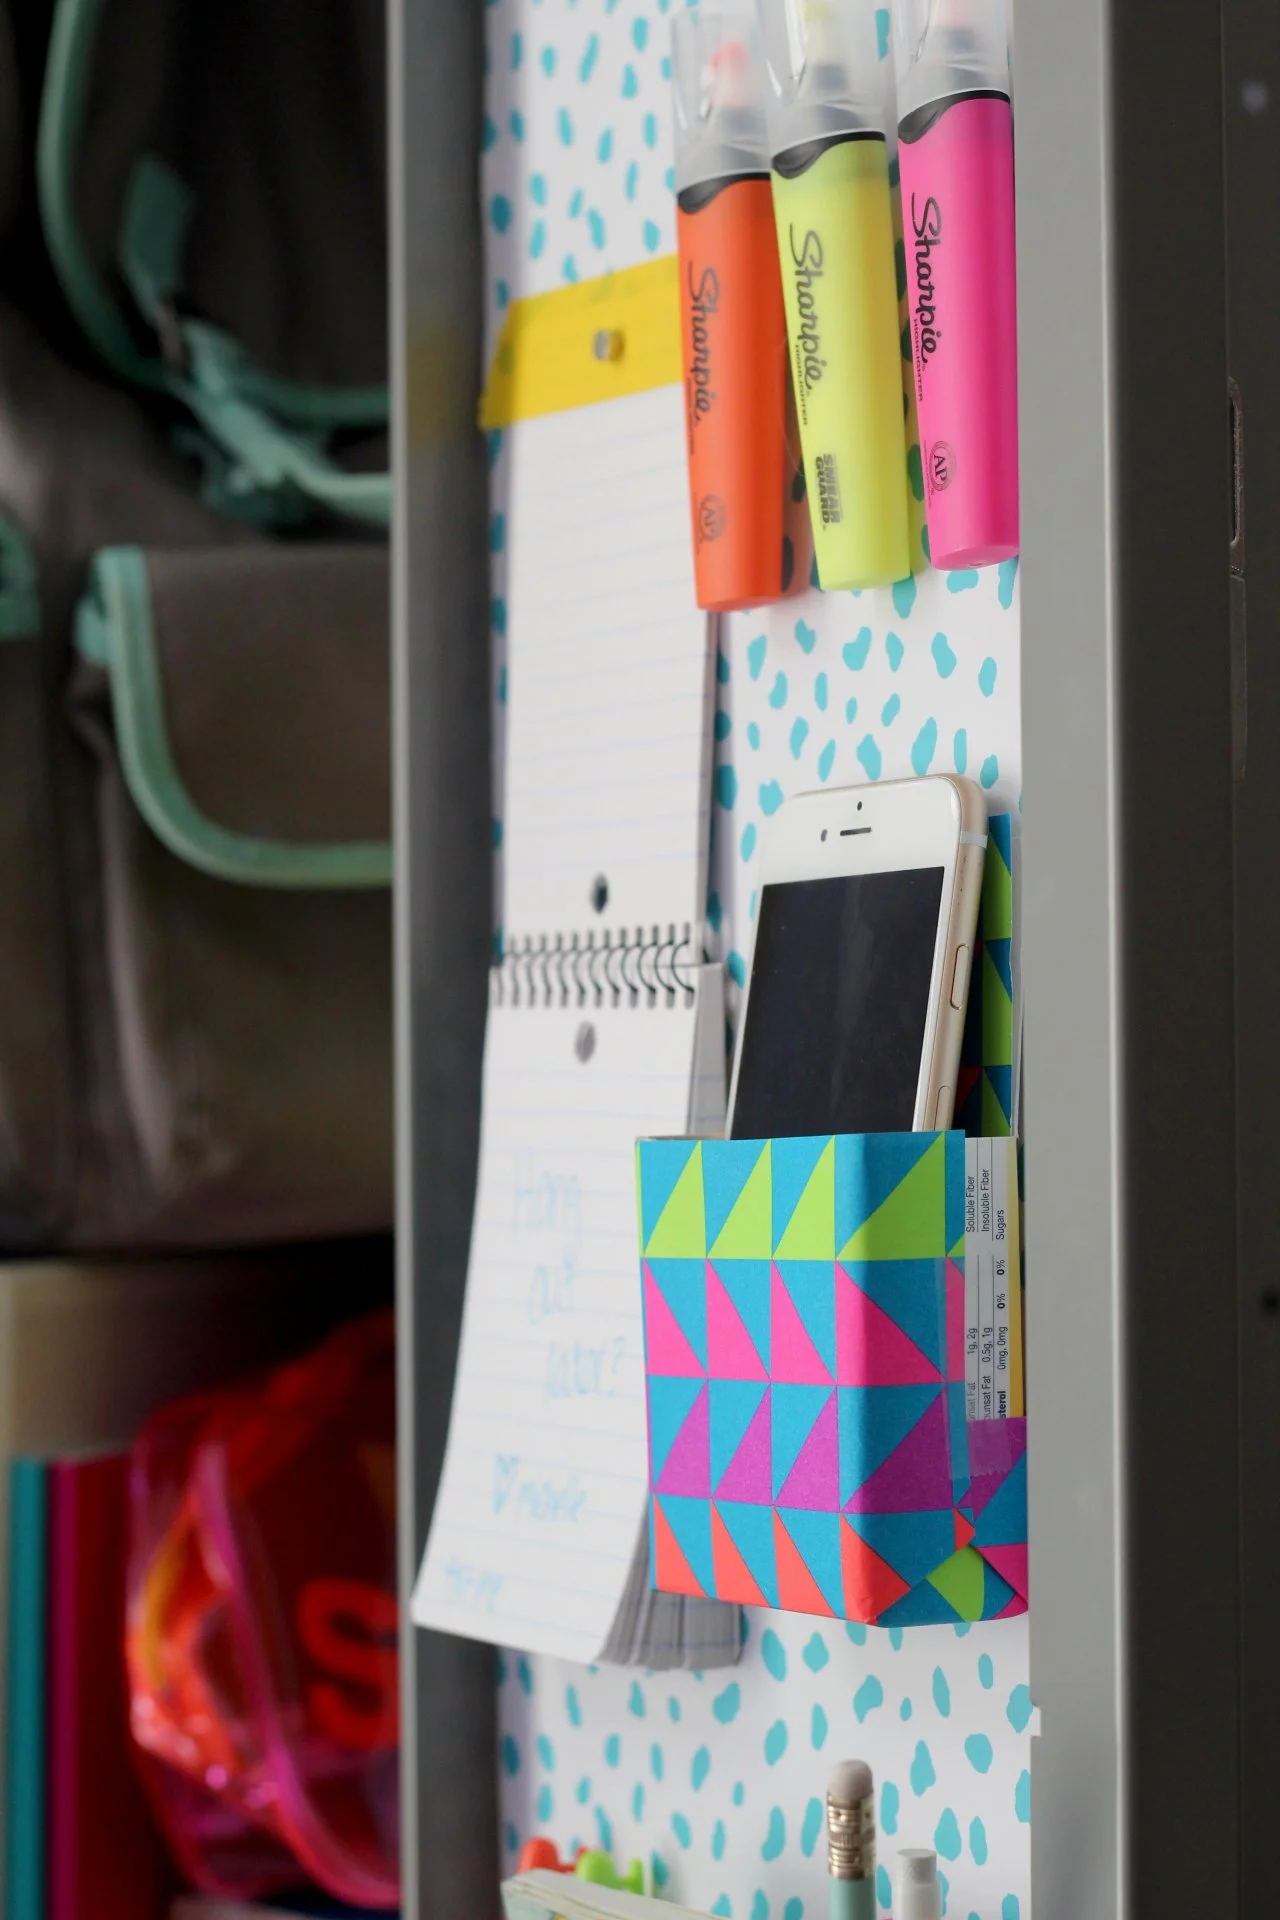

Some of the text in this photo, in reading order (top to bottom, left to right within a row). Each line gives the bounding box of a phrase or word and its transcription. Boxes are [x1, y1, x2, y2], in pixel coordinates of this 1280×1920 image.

[911, 192, 942, 364] Sharpie
[789, 223, 828, 392] Sharpie
[689, 259, 719, 422] Sharpie
[913, 318, 924, 403] HIGHLIGHTER
[795, 344, 808, 426] HIGHLIGHTER
[934, 455, 948, 481] AP
[816, 456, 830, 524] GUARD
[824, 453, 841, 524] SMEAR
[966, 1176, 975, 1232] Soluble Fiber
[981, 1169, 989, 1232] Insoluble Fiber
[996, 1209, 1006, 1240] Sugars
[996, 1259, 1006, 1276] 0%
[997, 1293, 1006, 1310] 0%
[967, 1327, 978, 1339] 2g
[982, 1327, 993, 1338] 1g
[997, 1326, 1008, 1346] 0mg
[967, 1341, 978, 1354] 1g,
[982, 1341, 993, 1363] 0.5g,
[997, 1348, 1008, 1370] 0mg,
[982, 1375, 991, 1390] Fat
